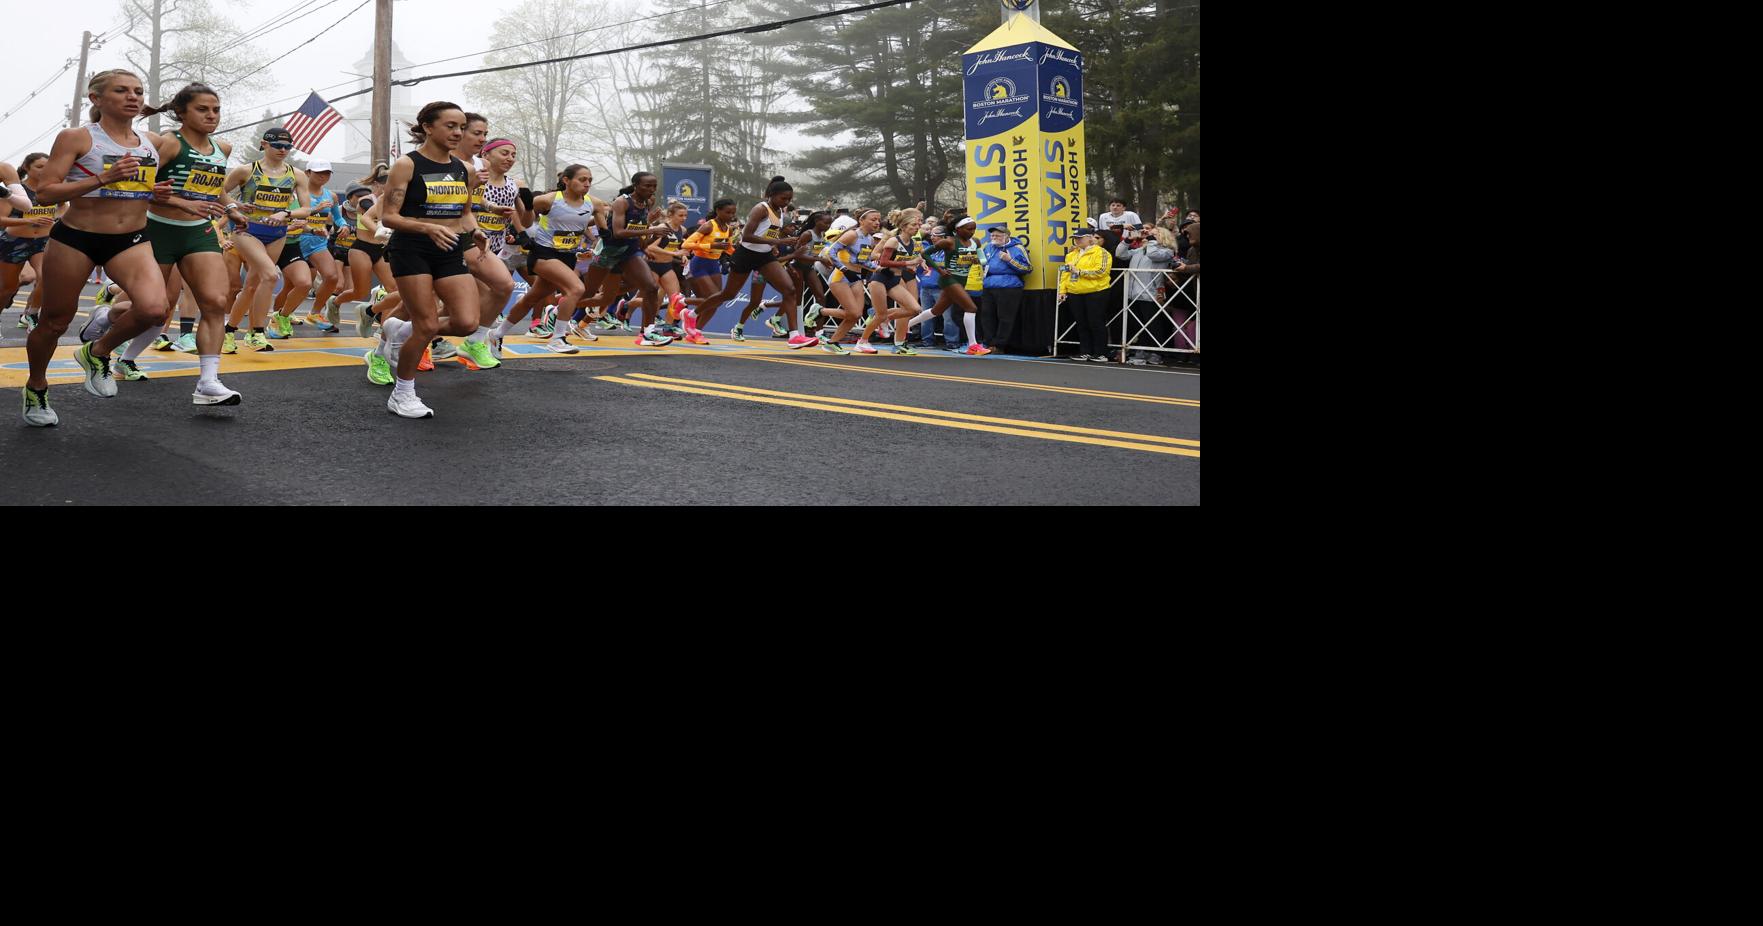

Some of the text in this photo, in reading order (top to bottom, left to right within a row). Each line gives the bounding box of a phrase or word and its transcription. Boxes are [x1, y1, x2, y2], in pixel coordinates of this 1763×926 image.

[966, 46, 1034, 76] John Hancock
[1039, 46, 1080, 70] John Hancock
[972, 95, 1030, 108] BOSTON MARATHON
[1056, 97, 1078, 105] MARATHON
[977, 106, 1023, 126] John Hancock
[1046, 105, 1075, 120] John Hancock
[191, 172, 224, 187] ROJAS
[256, 191, 290, 202] COOGAN
[427, 185, 467, 195] MONTOYA
[974, 143, 1008, 243] STAR
[1012, 149, 1030, 253] HOPKINTO
